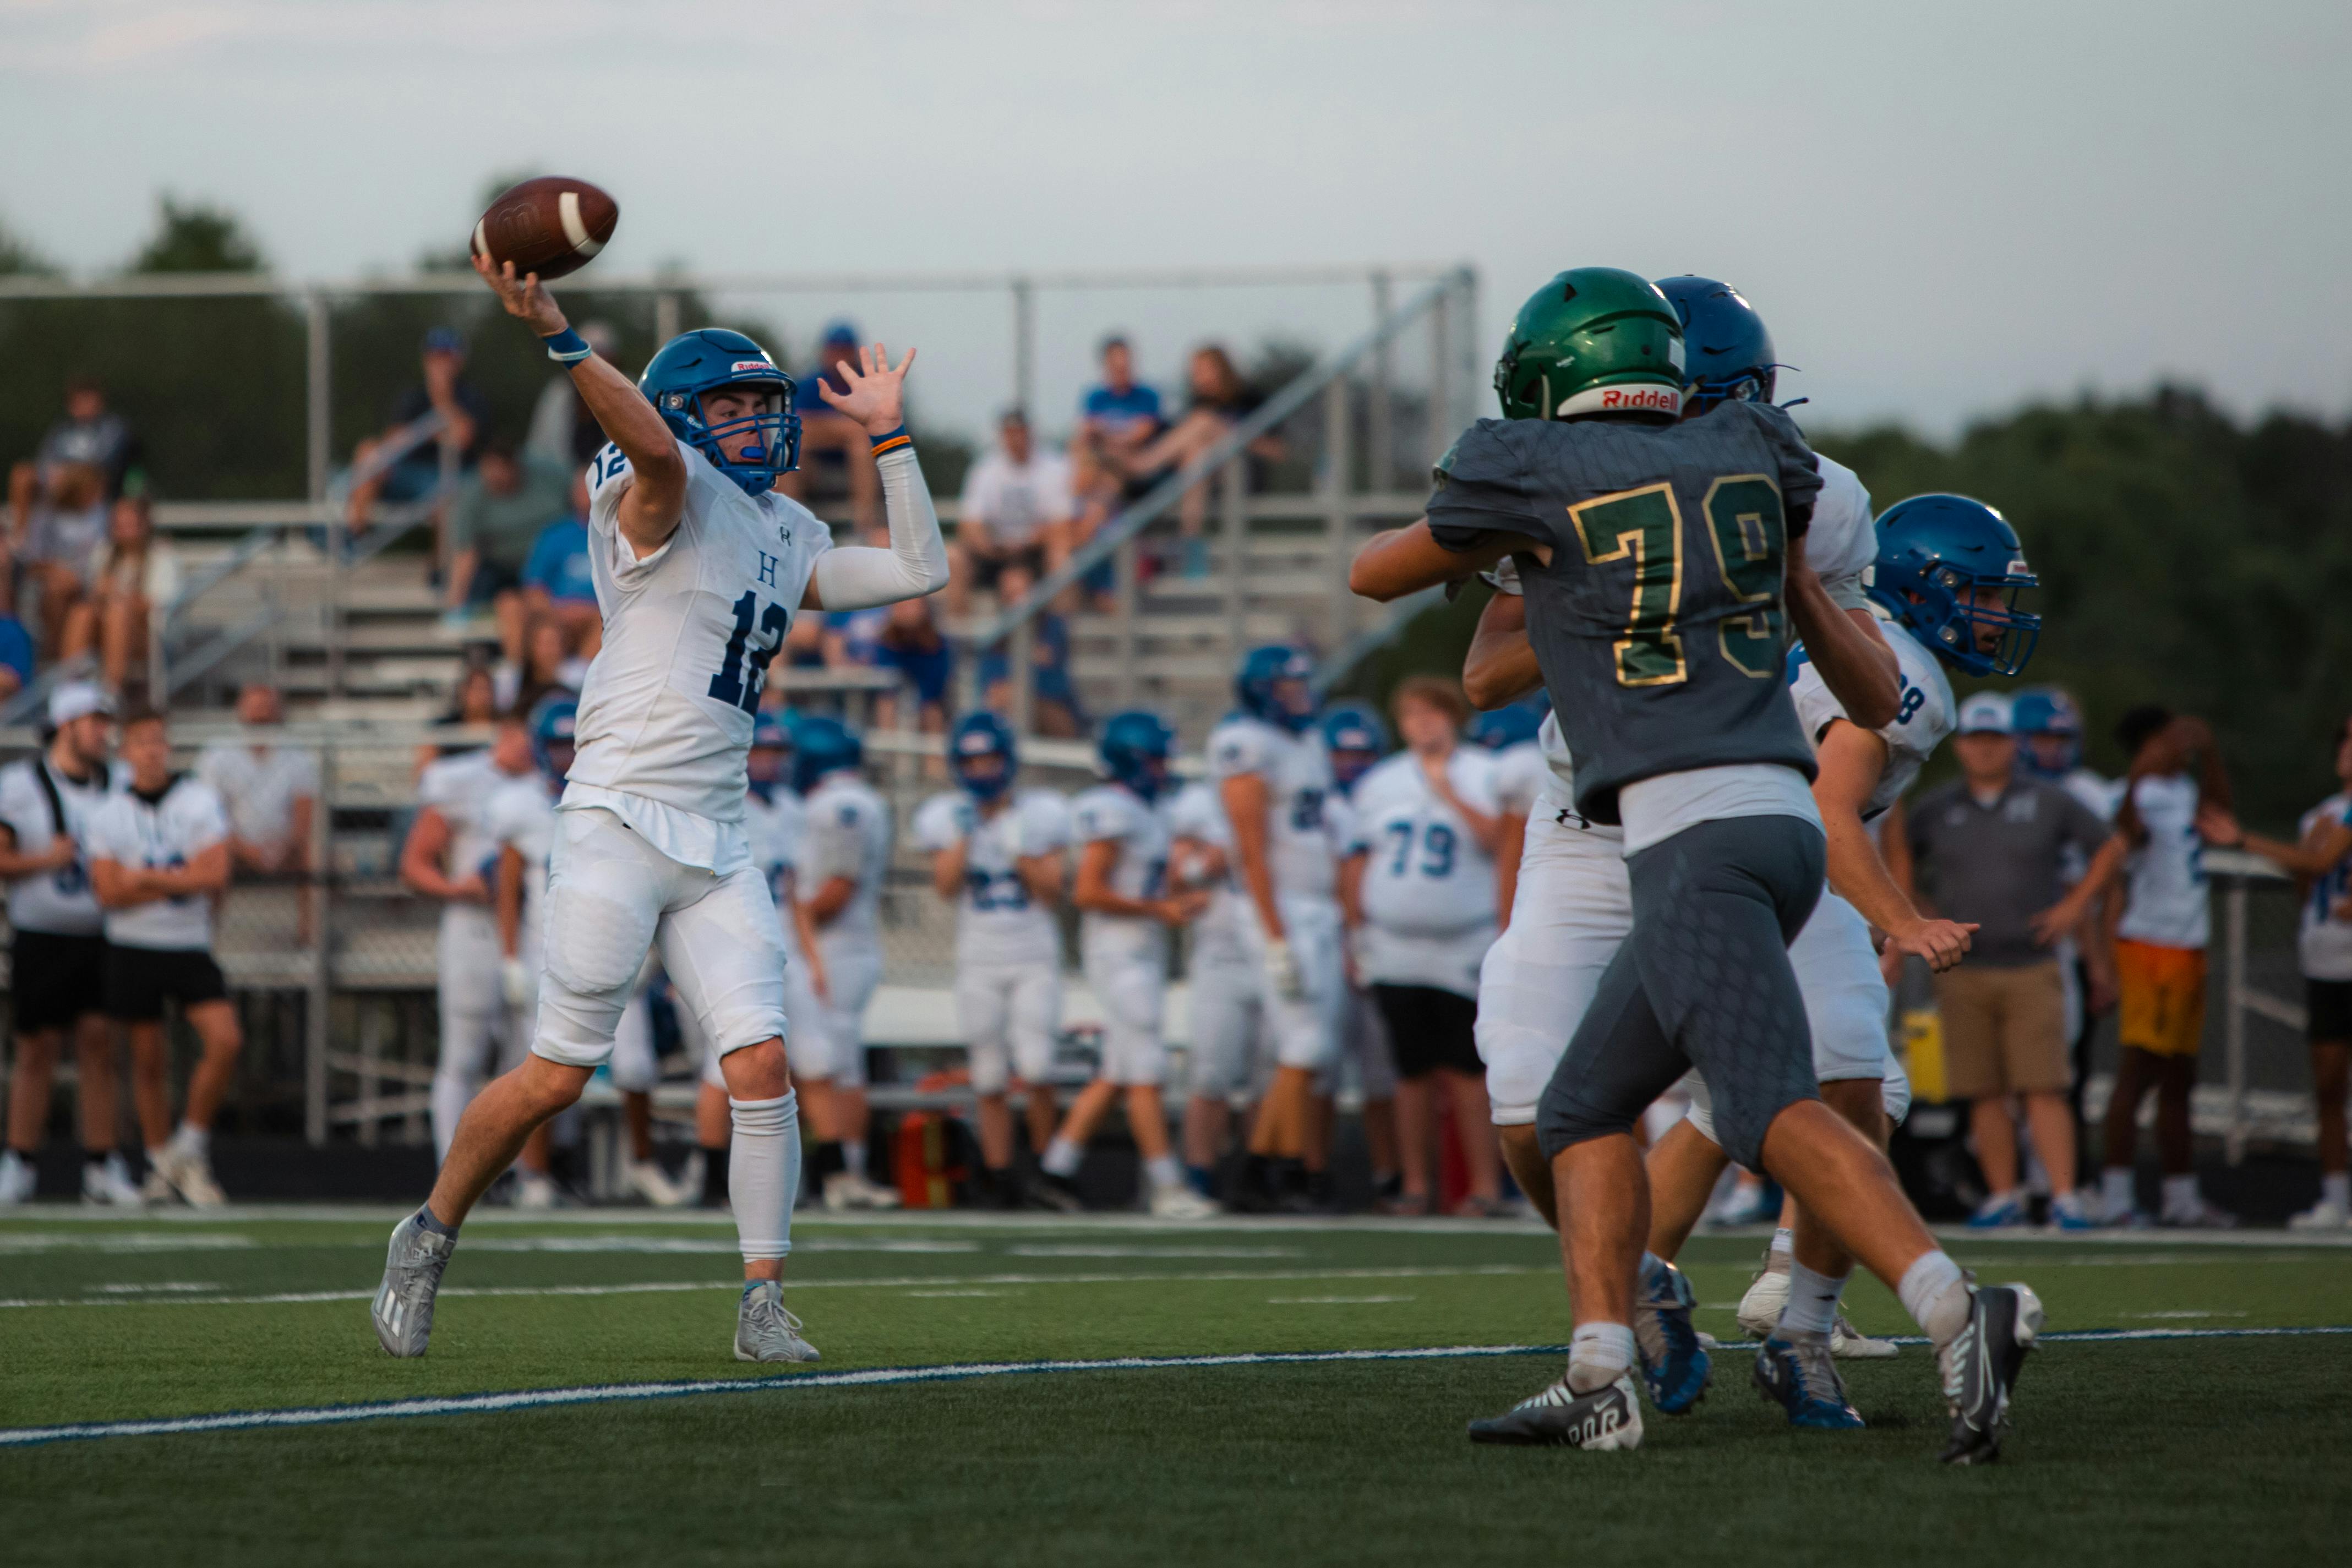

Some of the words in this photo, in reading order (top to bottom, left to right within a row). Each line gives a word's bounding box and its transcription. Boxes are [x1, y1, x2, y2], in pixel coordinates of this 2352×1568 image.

[1602, 390, 1678, 411] Riddell
[594, 443, 626, 490] 12
[757, 550, 779, 588] H
[1567, 473, 1788, 687] 79
[707, 590, 788, 717] 12
[1385, 819, 1456, 877] 79
